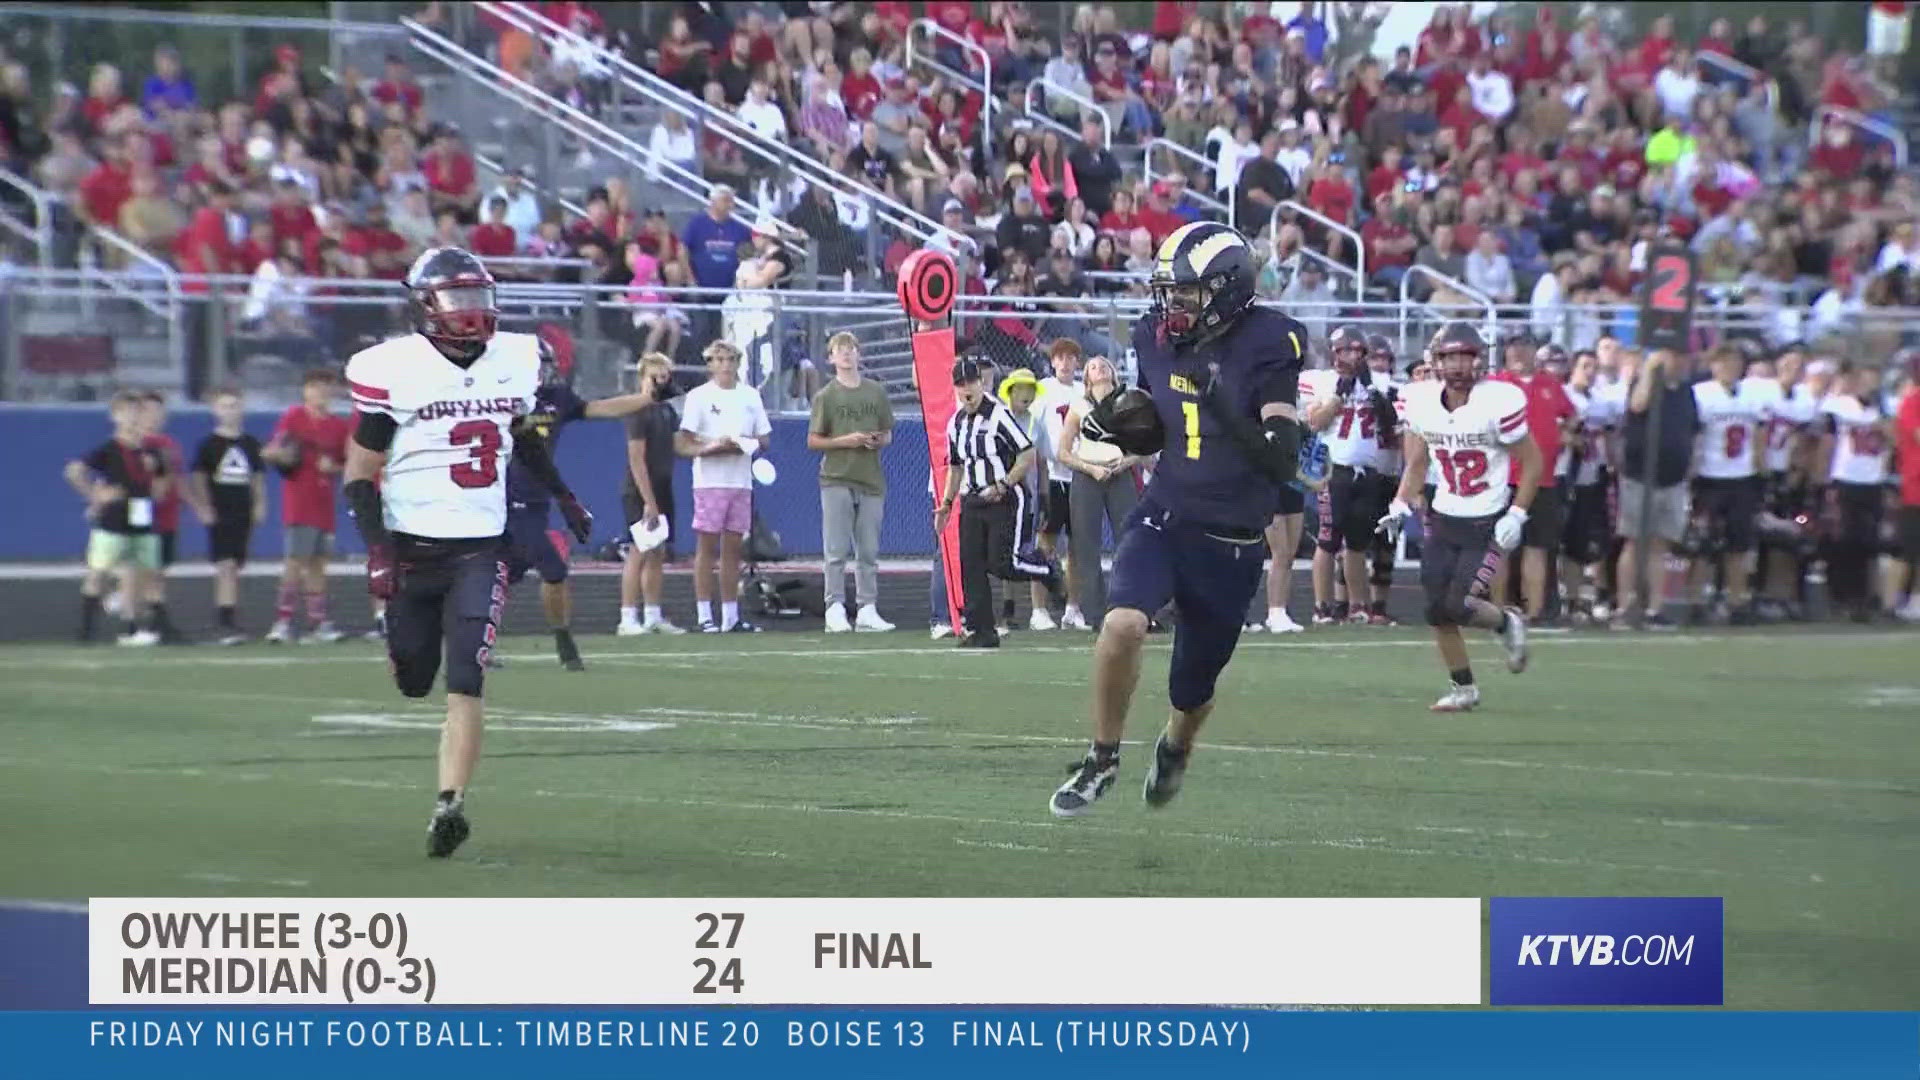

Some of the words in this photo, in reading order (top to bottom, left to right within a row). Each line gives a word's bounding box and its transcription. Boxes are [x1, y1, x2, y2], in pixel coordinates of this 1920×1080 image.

[1650, 256, 1690, 309] 2
[448, 419, 502, 489] 3
[1182, 401, 1201, 460] 1
[1435, 448, 1490, 498] 12
